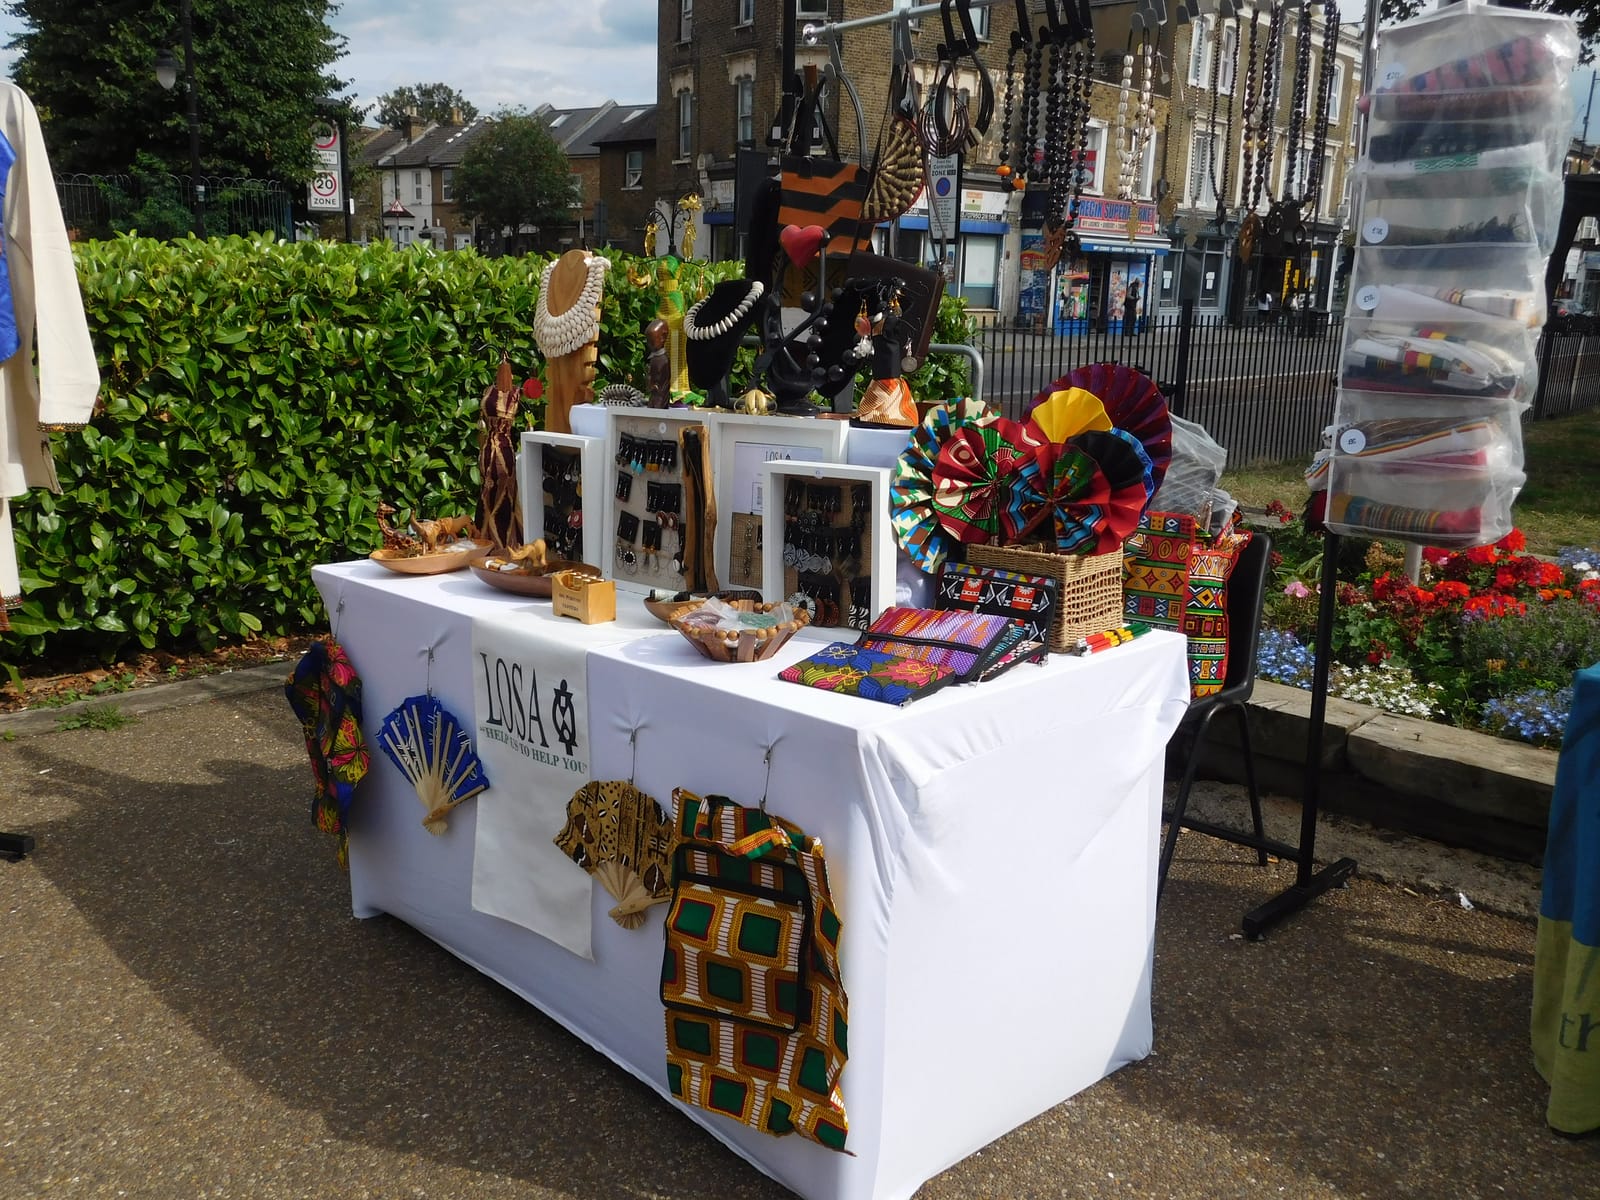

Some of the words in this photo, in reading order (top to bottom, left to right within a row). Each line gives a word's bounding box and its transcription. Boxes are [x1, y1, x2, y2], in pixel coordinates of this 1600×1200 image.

[316, 179, 333, 190] 20
[314, 198, 336, 206] ZONE
[479, 652, 549, 748] LOSA
[510, 736, 519, 751] US
[519, 743, 530, 758] TO
[532, 748, 559, 767] HELP
